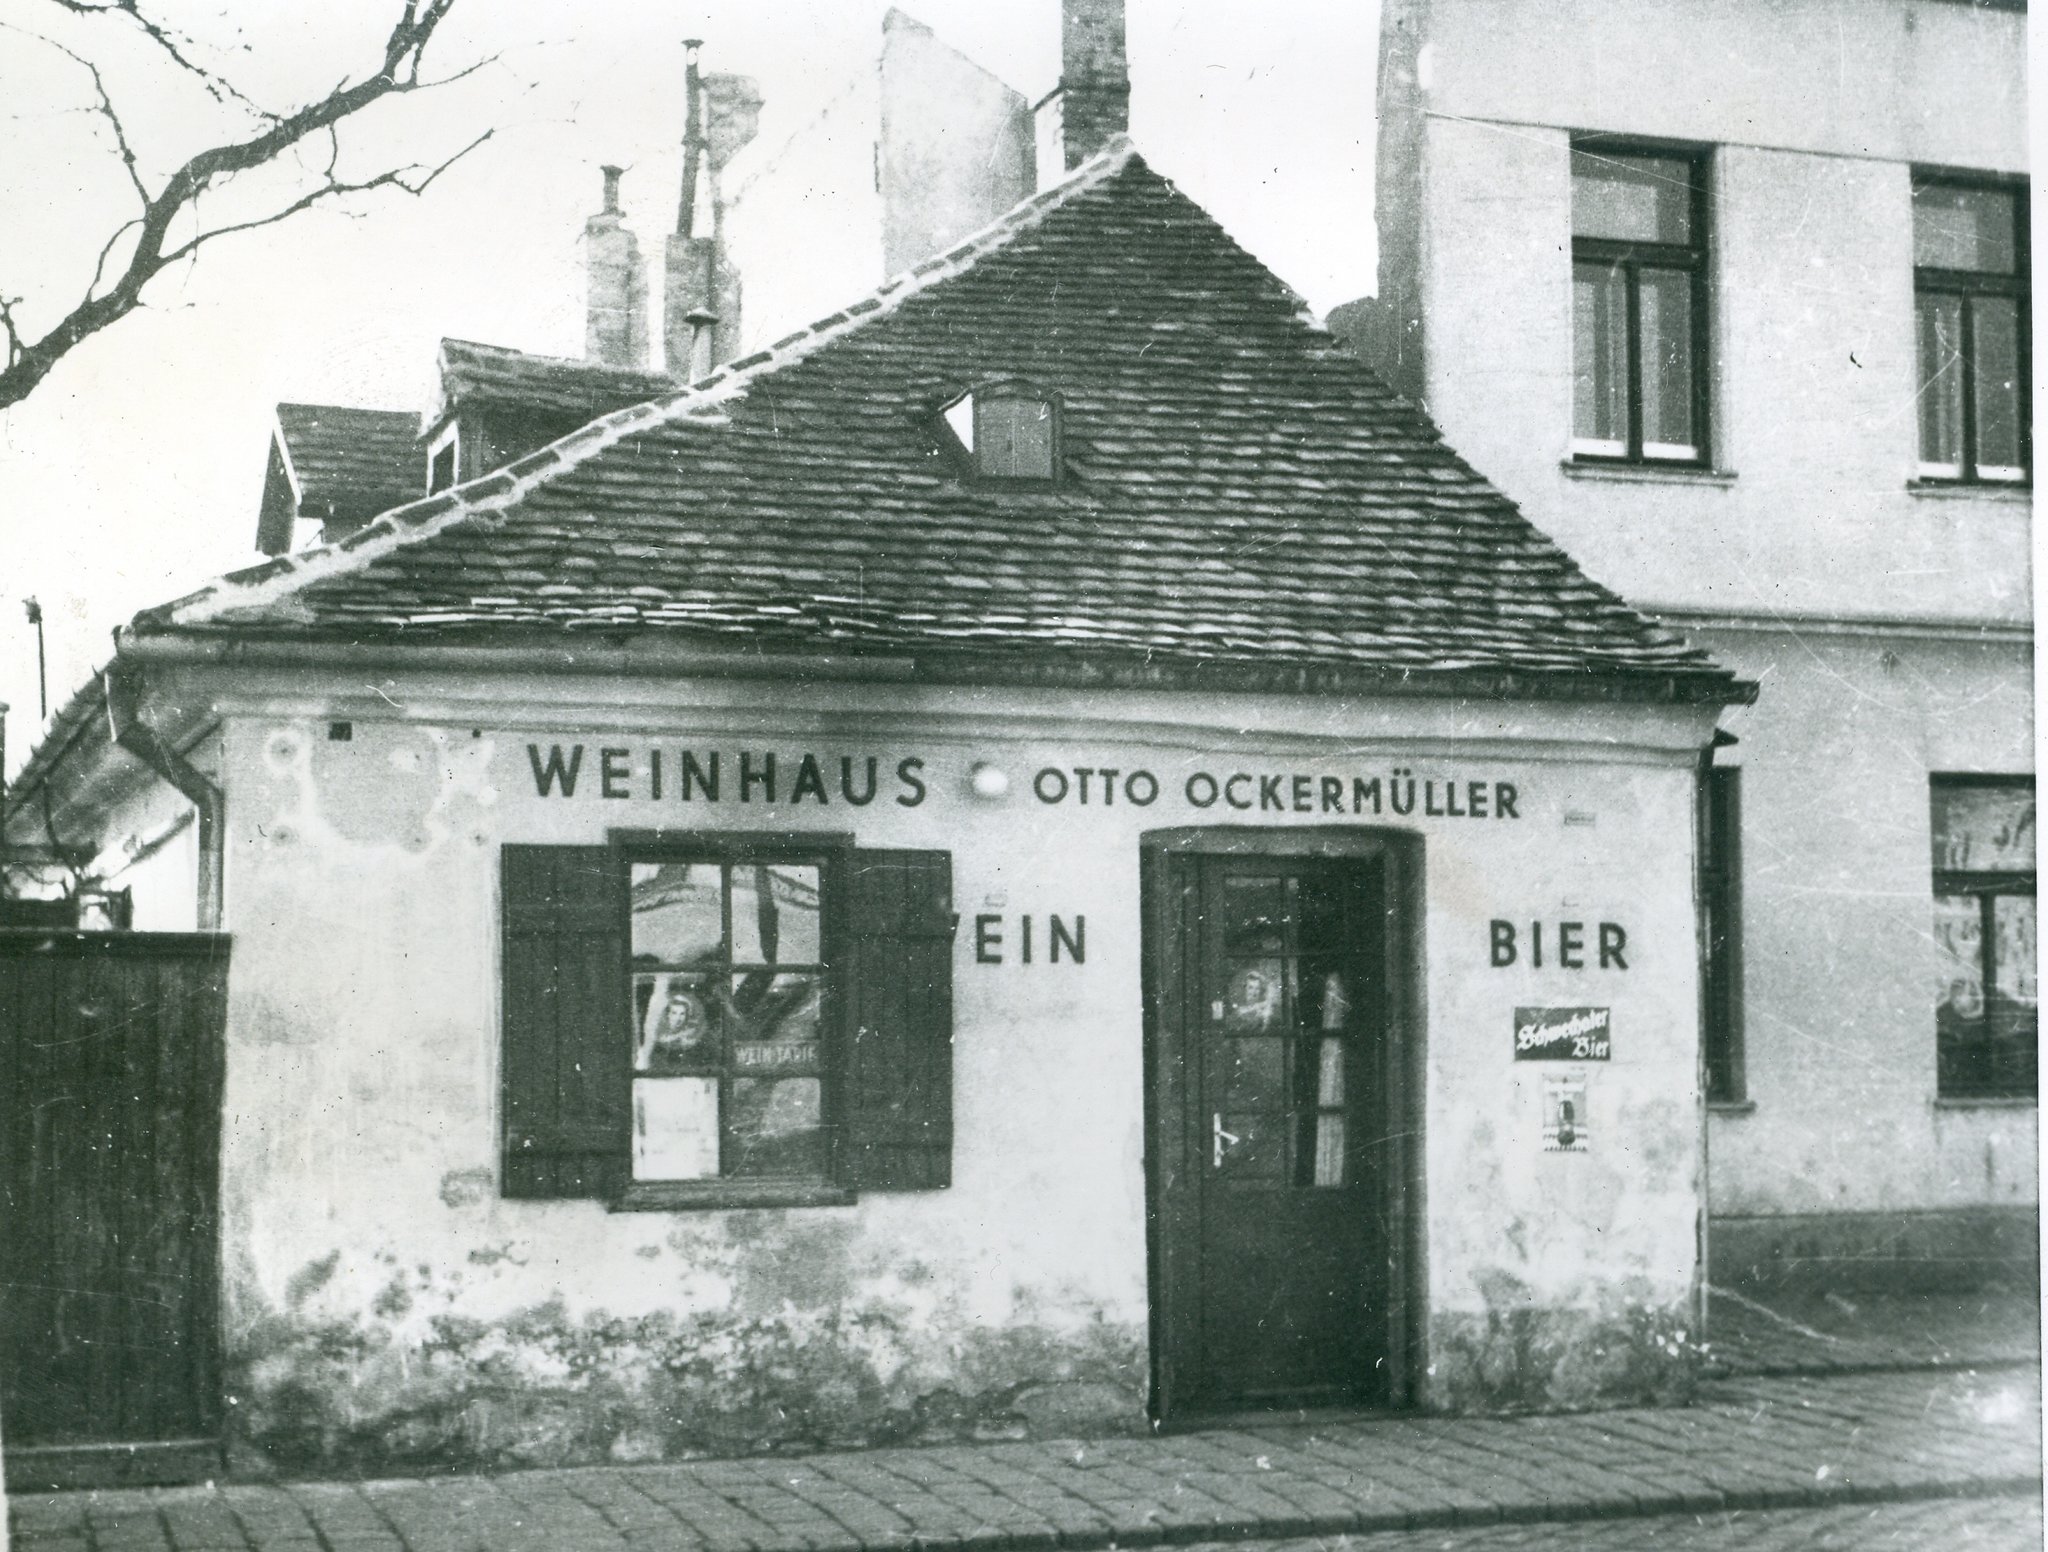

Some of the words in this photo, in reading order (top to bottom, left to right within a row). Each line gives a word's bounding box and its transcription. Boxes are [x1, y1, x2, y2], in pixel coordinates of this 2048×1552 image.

[527, 744, 927, 808] WEINHAUS
[1033, 767, 1159, 807] OTTO
[1185, 768, 1520, 819] OCKERMÜLLER
[951, 913, 1086, 965] EIN
[1489, 919, 1629, 970] BIER
[1571, 1036, 1609, 1058] Bier
